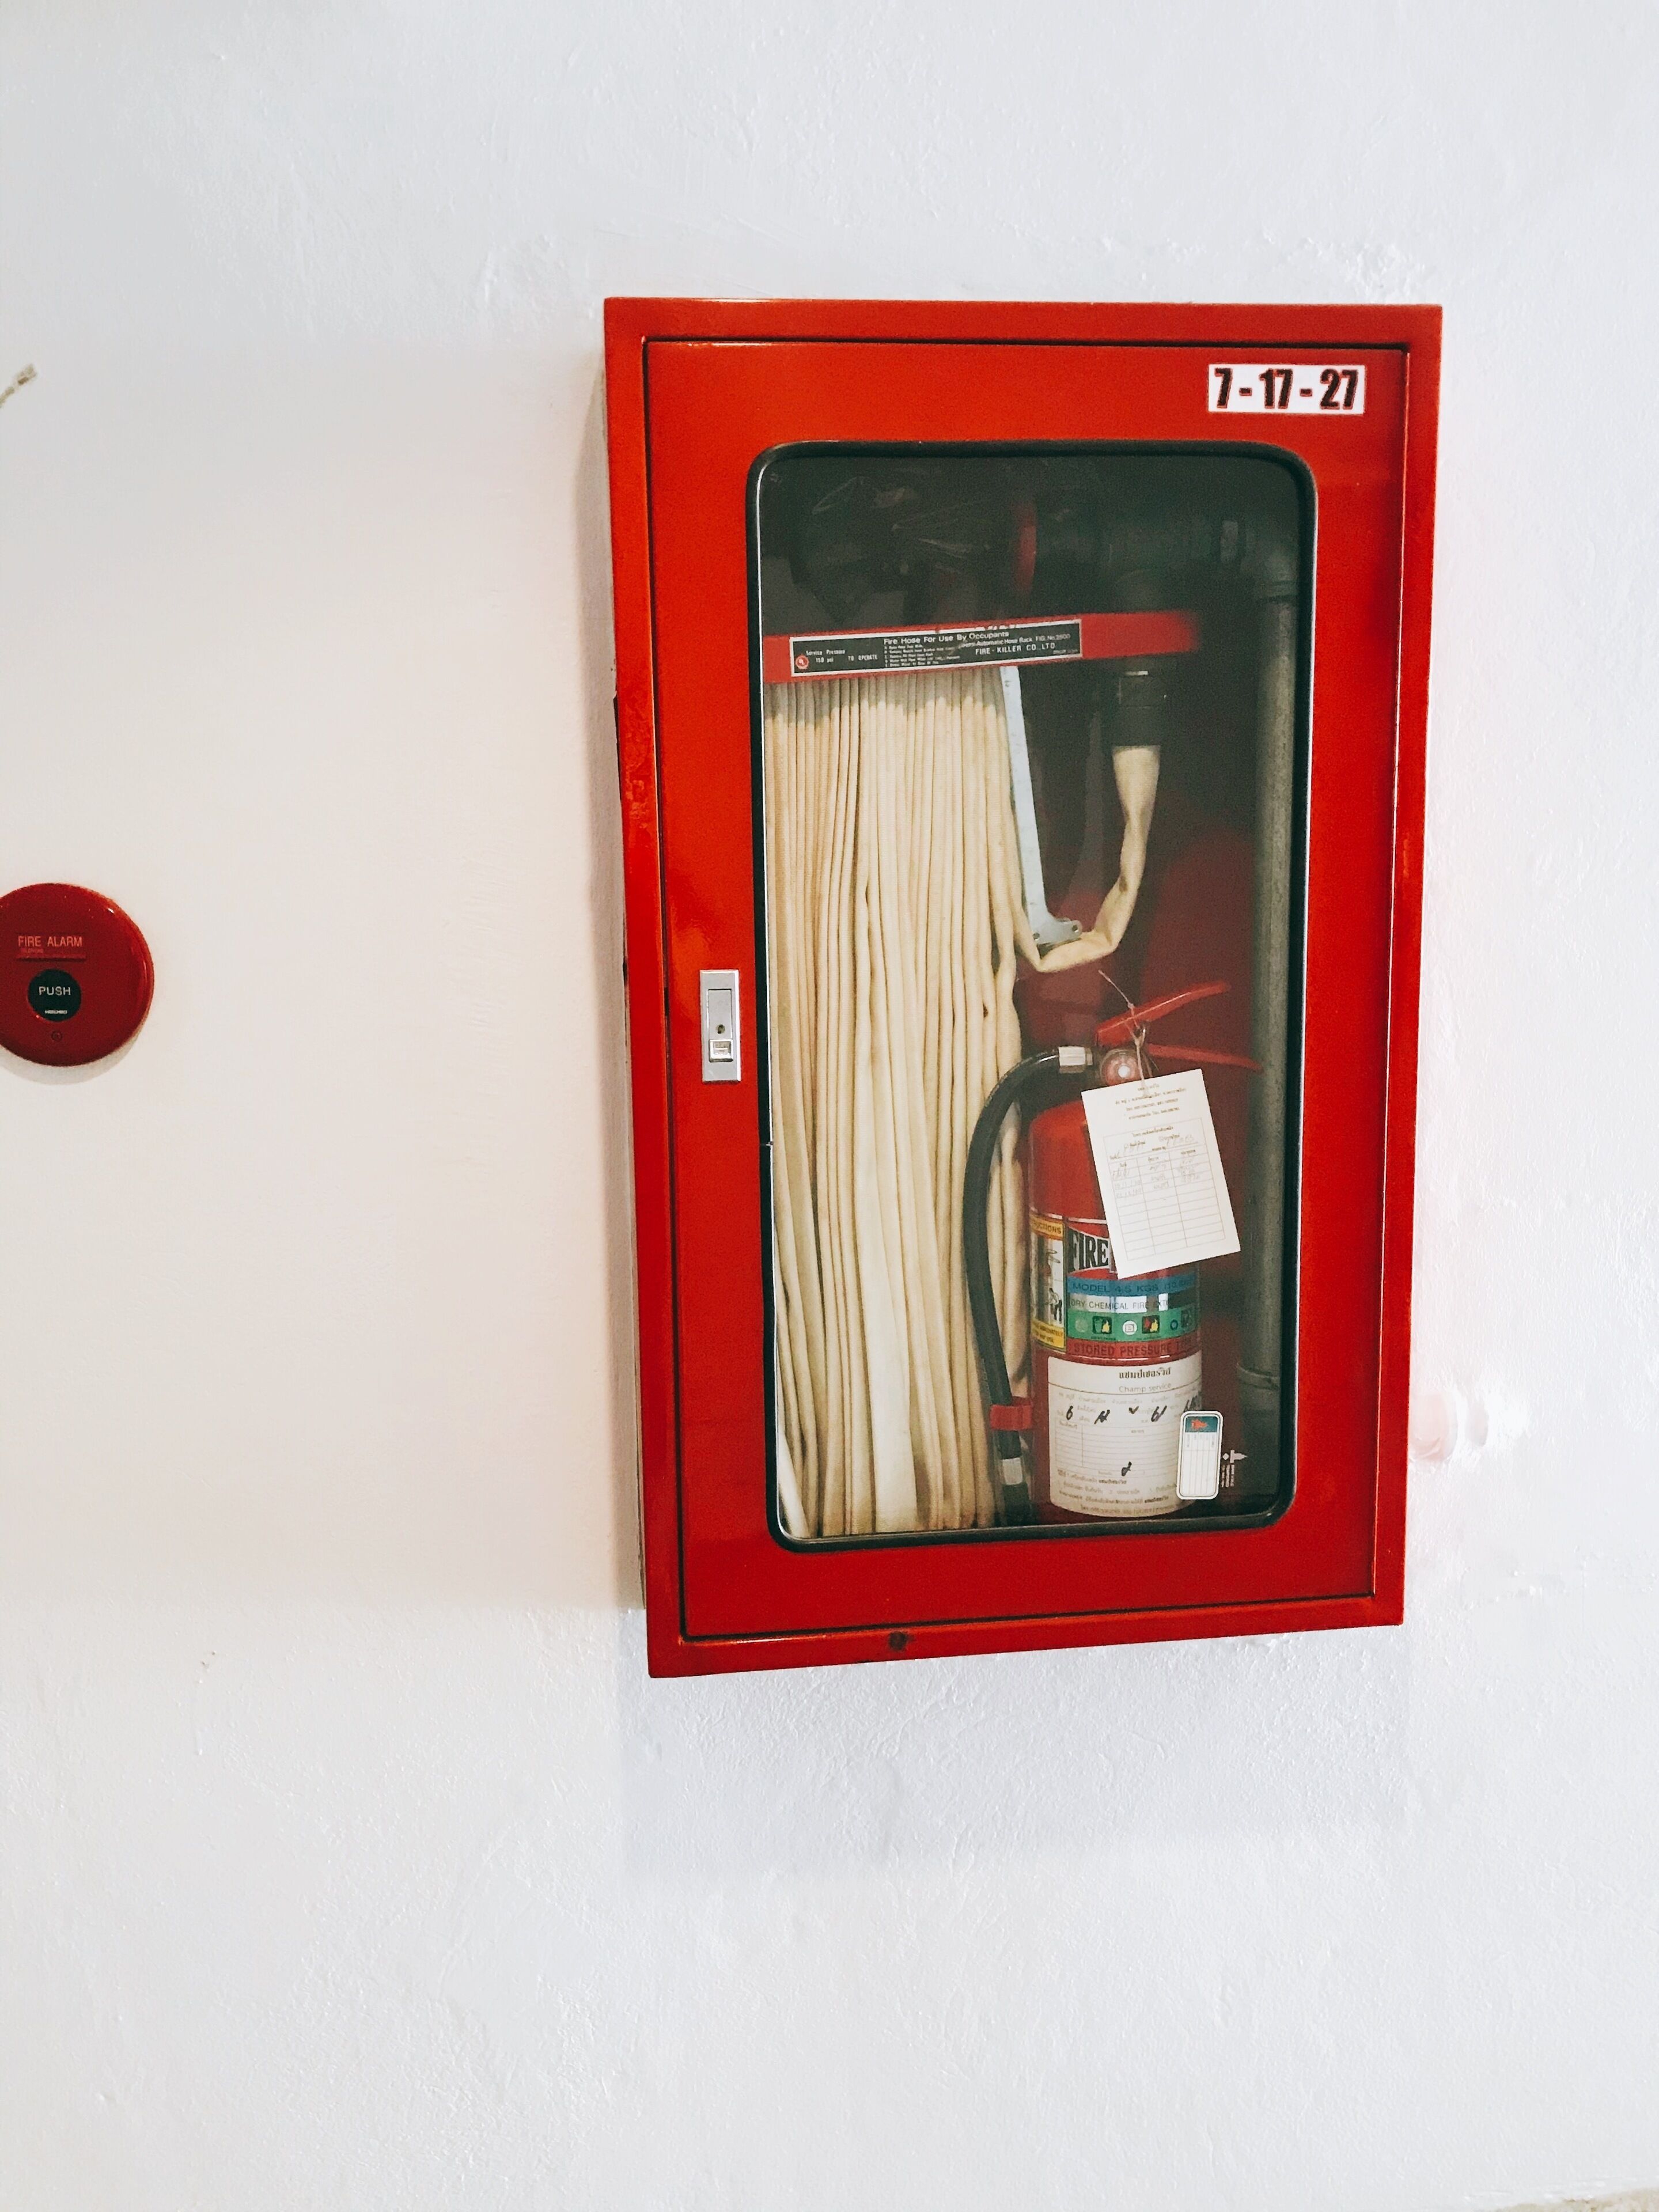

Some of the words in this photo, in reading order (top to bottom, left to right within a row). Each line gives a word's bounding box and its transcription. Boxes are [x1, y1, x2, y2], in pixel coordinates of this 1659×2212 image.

[969, 631, 1009, 639] Occupants
[997, 645, 1021, 653] KILLER
[18, 935, 41, 947] FIRE
[47, 935, 82, 947] ALARM
[39, 986, 71, 996] PUSH
[1068, 1228, 1109, 1274] FIRE
[1073, 1282, 1110, 1293] MODEL
[1071, 1299, 1085, 1307] DRY
[1089, 1301, 1128, 1309] CHEMICAL
[1074, 1344, 1115, 1355] STORED
[1120, 1342, 1173, 1356] PRESSURE
[1119, 1385, 1146, 1394] Champ
[1149, 1382, 1172, 1392] service
